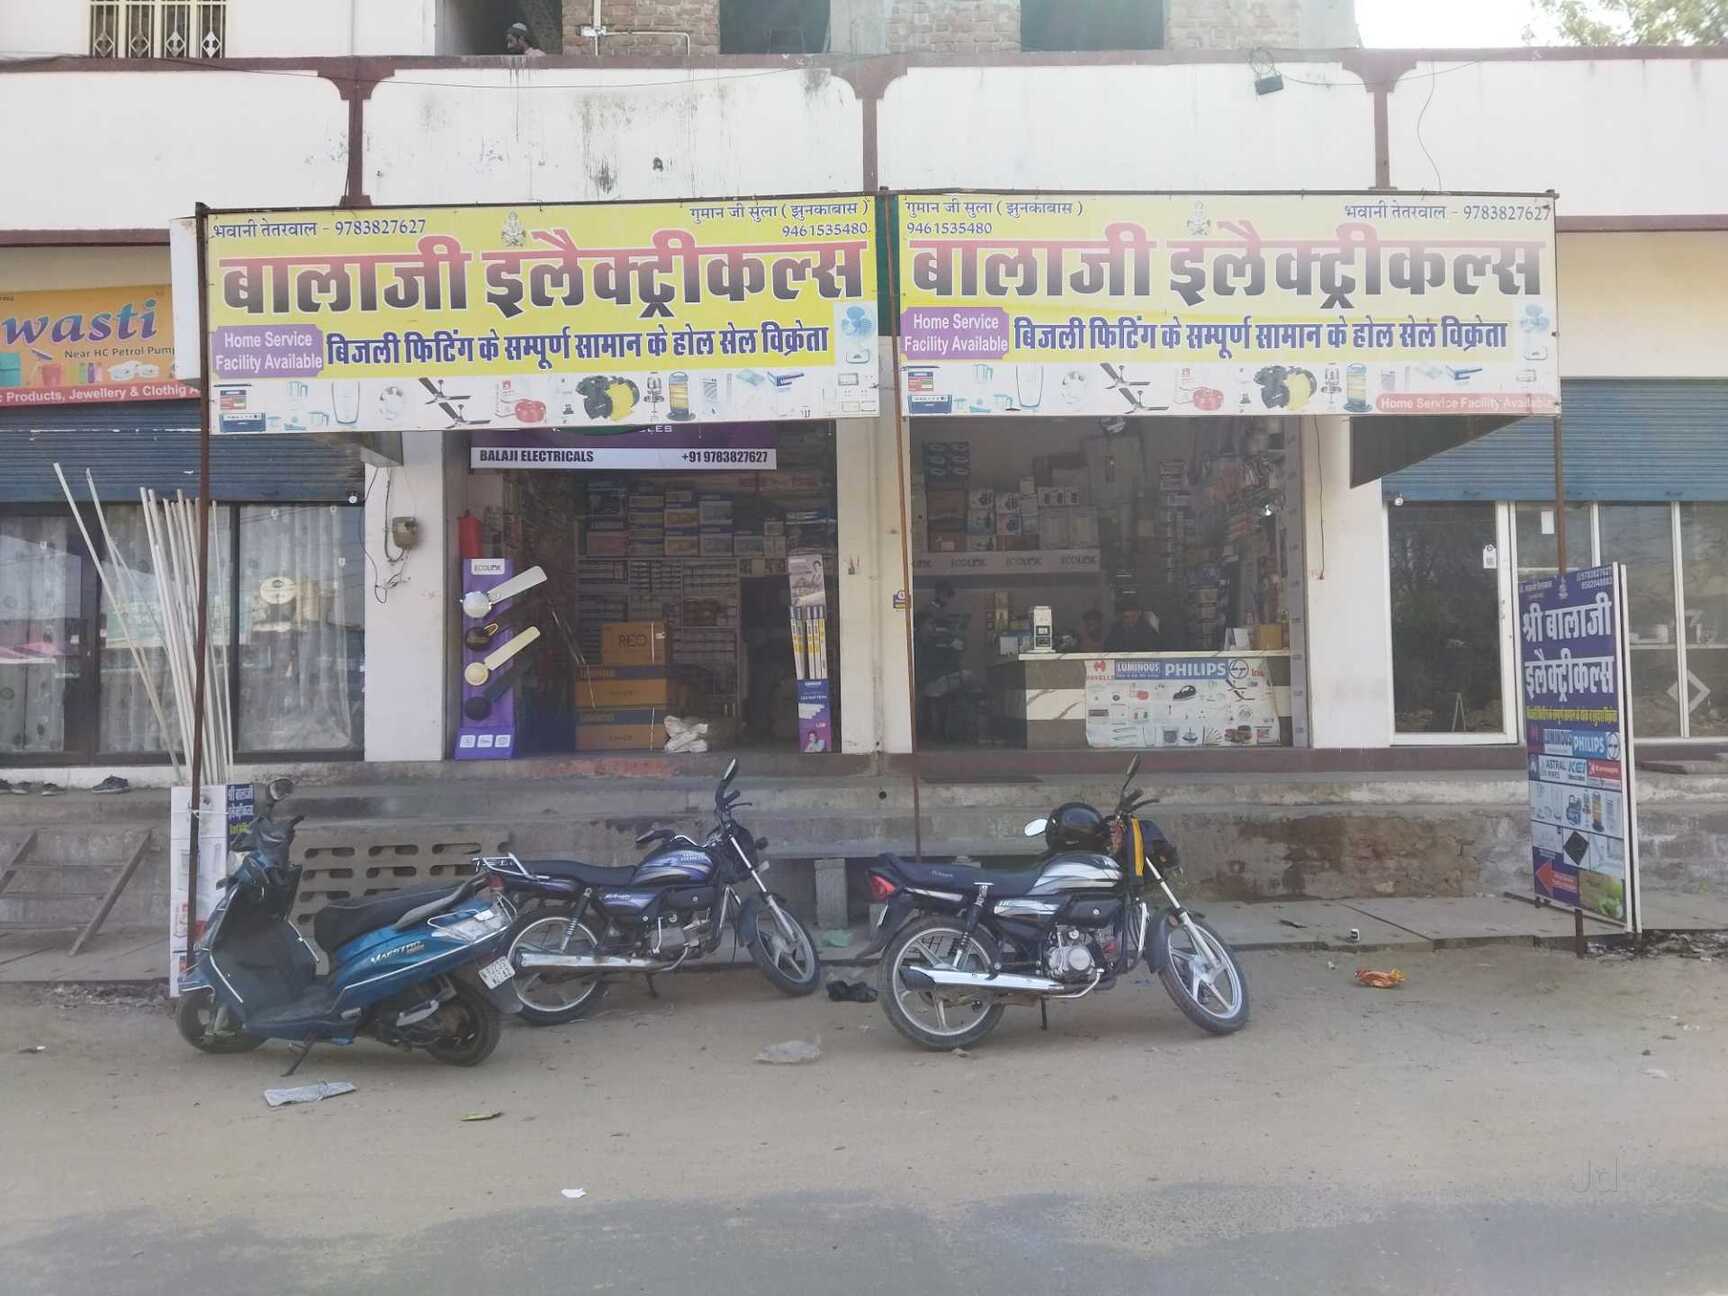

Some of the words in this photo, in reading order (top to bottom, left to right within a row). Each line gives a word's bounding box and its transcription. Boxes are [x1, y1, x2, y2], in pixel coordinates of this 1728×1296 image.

[727, 203, 745, 218] जी
[943, 199, 960, 214] जी
[1344, 200, 1387, 219] भवानी
[1391, 200, 1447, 219] तेतरवाल
[1464, 205, 1551, 220] 9783827627
[213, 219, 257, 238] भवानी
[260, 218, 317, 236] तेतरवाल
[335, 219, 426, 235] 9783827627
[782, 222, 868, 237] 9461535480
[906, 222, 993, 234] 9461535480
[218, 234, 473, 314] बालाजी
[480, 228, 867, 318] इलैक्ट्रीकल्स
[909, 221, 1157, 296] बालाजी
[1166, 220, 1546, 309] इलैक्ट्रीकल्स
[913, 314, 949, 329] Home
[952, 313, 999, 330] Service
[224, 331, 262, 348] Home
[264, 330, 313, 347] Service
[326, 331, 401, 365] बिजली
[404, 330, 474, 363] फिटिंग
[478, 328, 500, 361] के
[504, 326, 572, 369] सम्पूर्ण
[575, 334, 642, 358] सामान
[646, 323, 668, 356] के
[671, 323, 715, 355] होल
[719, 321, 758, 354] सेल
[761, 320, 829, 356] विक्रेता
[904, 335, 949, 355] Facility
[951, 335, 1009, 352] Available
[1013, 316, 1086, 350] बिजली
[1089, 315, 1159, 349] फिटिंग
[1161, 316, 1182, 349] के
[1186, 315, 1252, 359] सम्पूर्ण
[1256, 323, 1324, 349] सामान
[1326, 315, 1348, 348] के
[1352, 314, 1395, 348] होल
[1399, 314, 1437, 348] सेल
[1441, 314, 1508, 351] विक्रेता
[64, 350, 90, 359] Near
[112, 347, 144, 356] Petrol
[215, 353, 262, 373] Facility
[263, 352, 323, 369] Available
[69, 388, 127, 400] Jewellery
[130, 387, 139, 397] &
[1381, 397, 1413, 409] Home
[1416, 397, 1461, 409] Service
[1461, 397, 1502, 411] Facility
[1503, 397, 1553, 409] Avail
[480, 450, 519, 462] BALAJI
[520, 450, 594, 463] ELECTRICALS
[681, 451, 701, 463] +91
[703, 450, 768, 463] 9783827627
[1522, 603, 1544, 642] श्री
[1544, 591, 1612, 640] बालाजी
[1116, 663, 1160, 673] LUMINOUS
[1165, 663, 1226, 677] PHILIPS
[1573, 735, 1605, 753] PHILIPS
